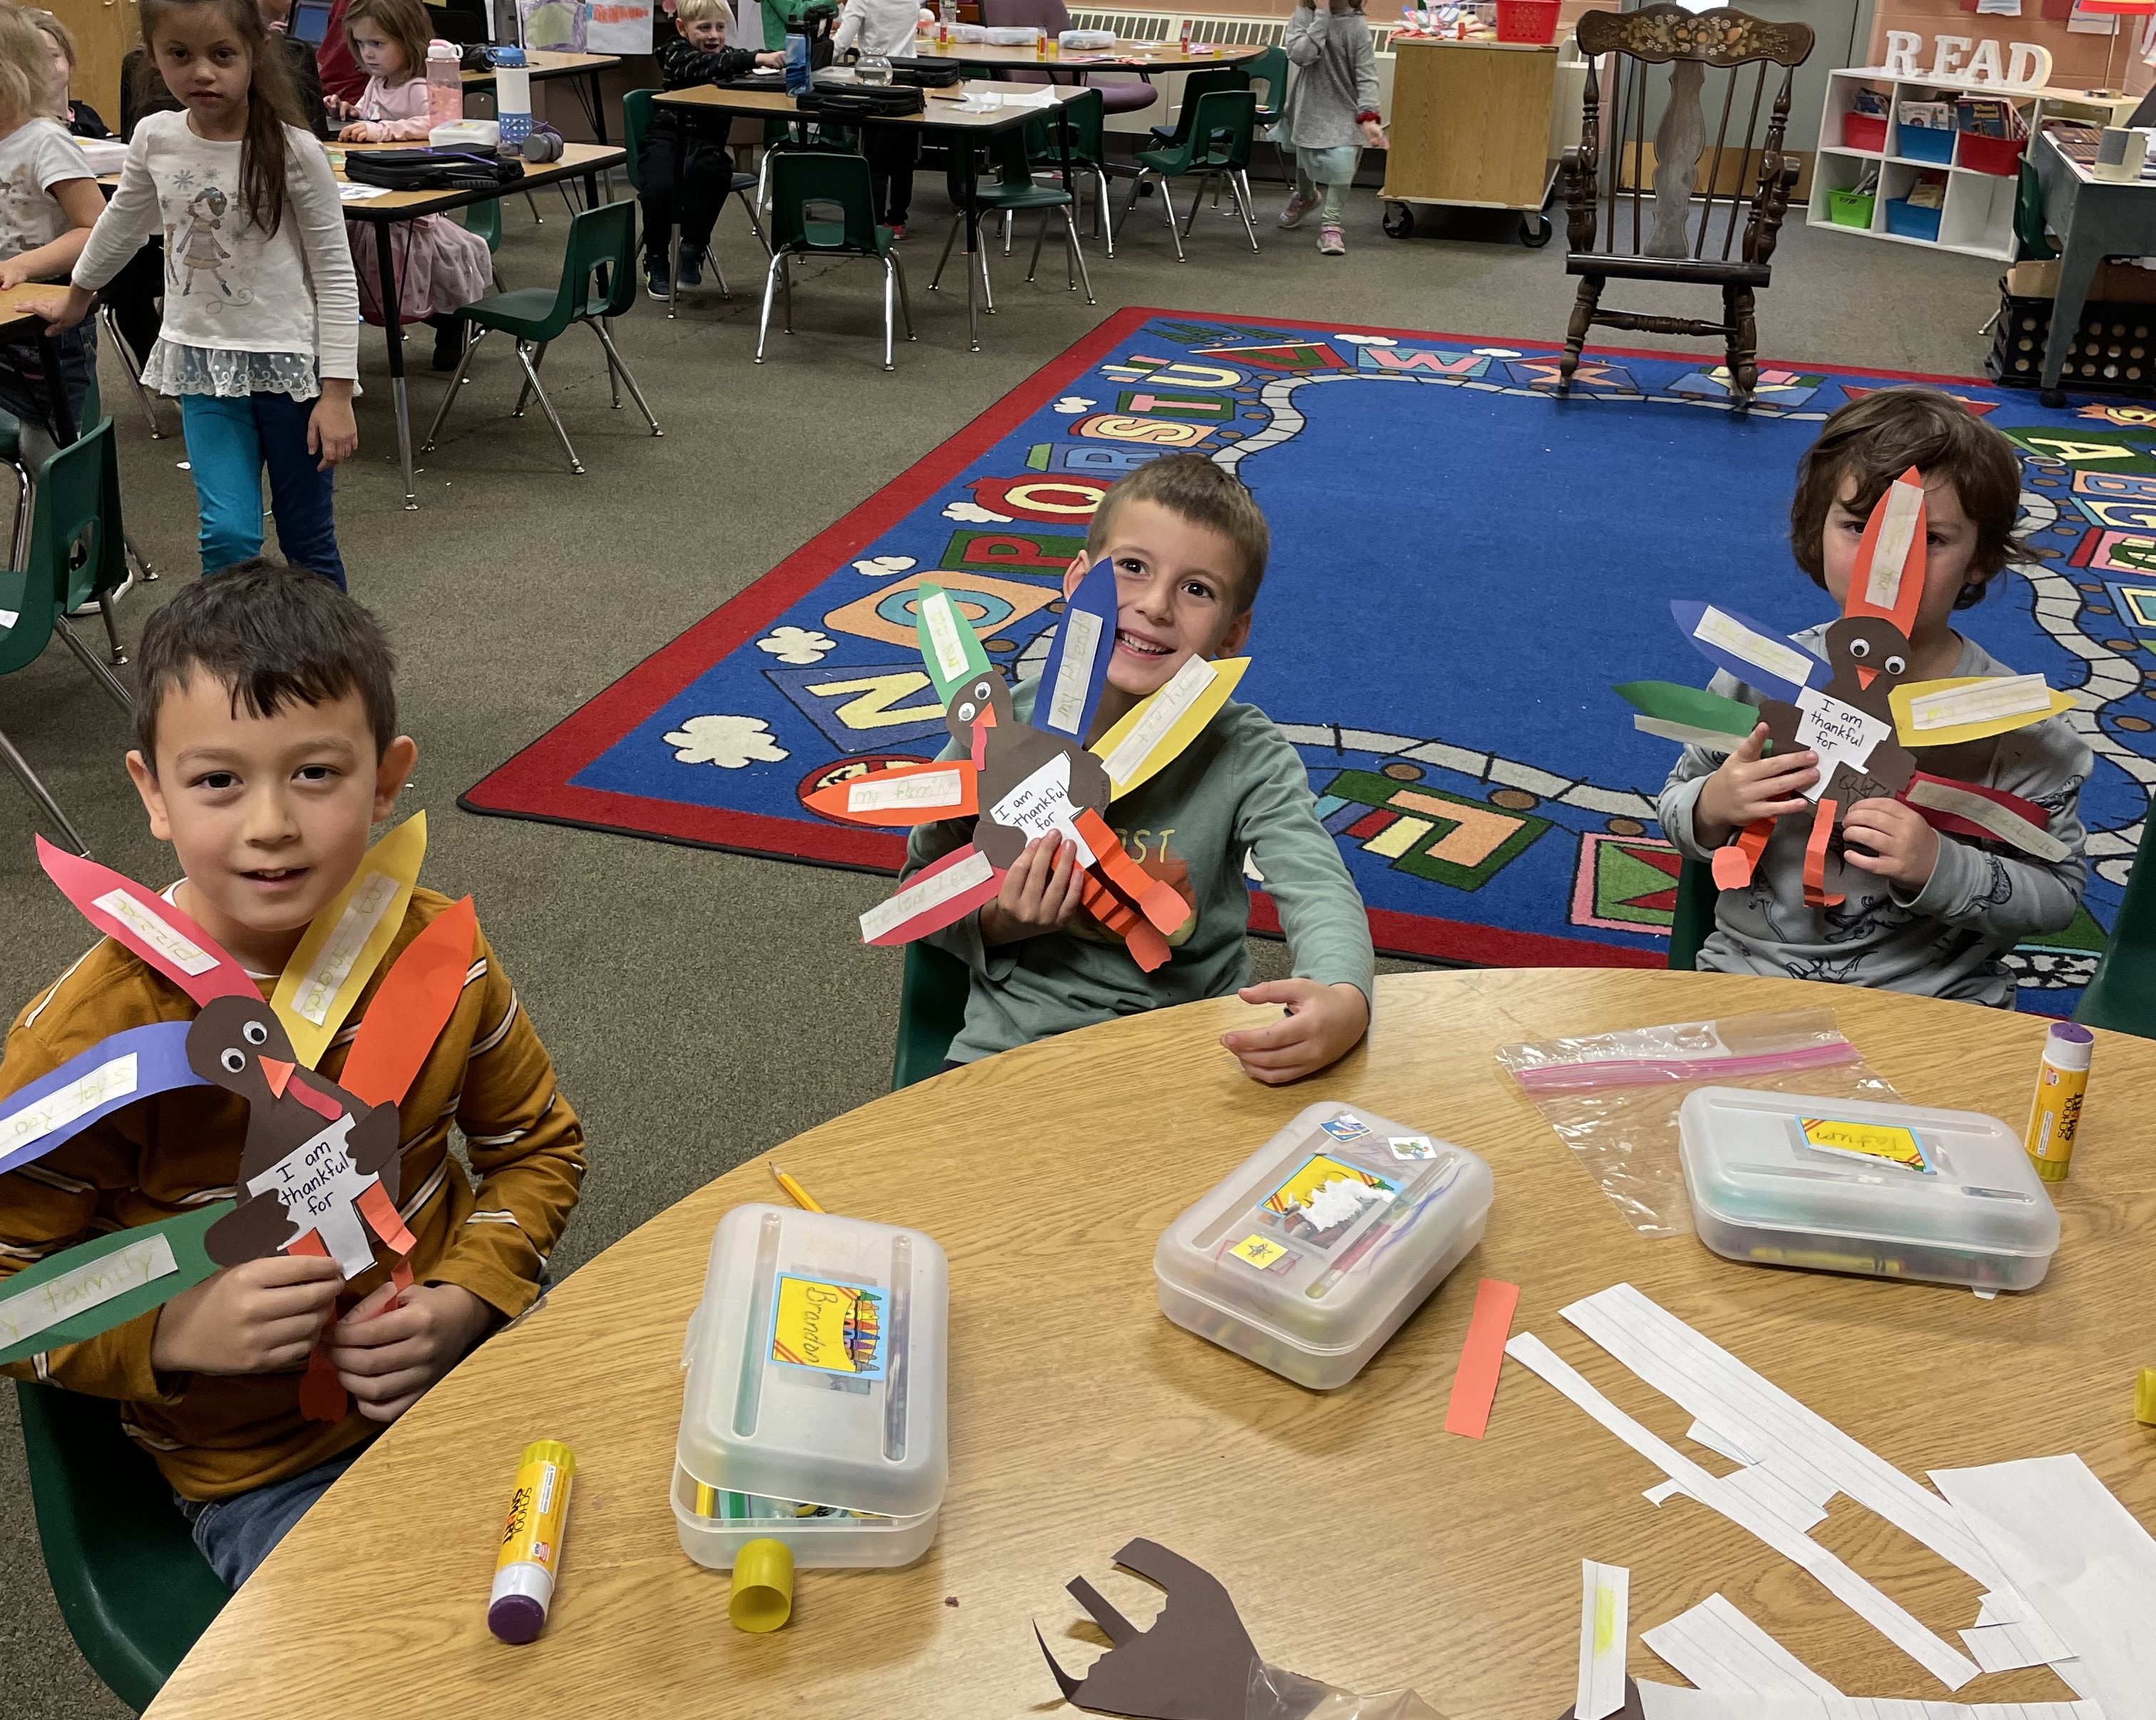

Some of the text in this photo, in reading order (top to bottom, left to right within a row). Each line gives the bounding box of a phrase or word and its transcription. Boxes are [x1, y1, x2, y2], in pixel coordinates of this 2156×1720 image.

[1881, 29, 2053, 91] READ
[1811, 710, 1864, 747] thankful
[1820, 698, 1862, 729] I am
[1815, 731, 1838, 750] for
[995, 789, 1033, 821] I am
[1012, 780, 1068, 827] thankful
[1035, 811, 1055, 831] for
[2057, 1097, 2074, 1138] SCHOOL
[2065, 1092, 2083, 1141] SMART
[275, 1141, 332, 1183] I am
[280, 1151, 349, 1207] thankful
[307, 1191, 334, 1216] for
[803, 1286, 839, 1363] Brandon
[502, 1488, 523, 1545] SMART
[513, 1487, 533, 1535] SCHOOL
